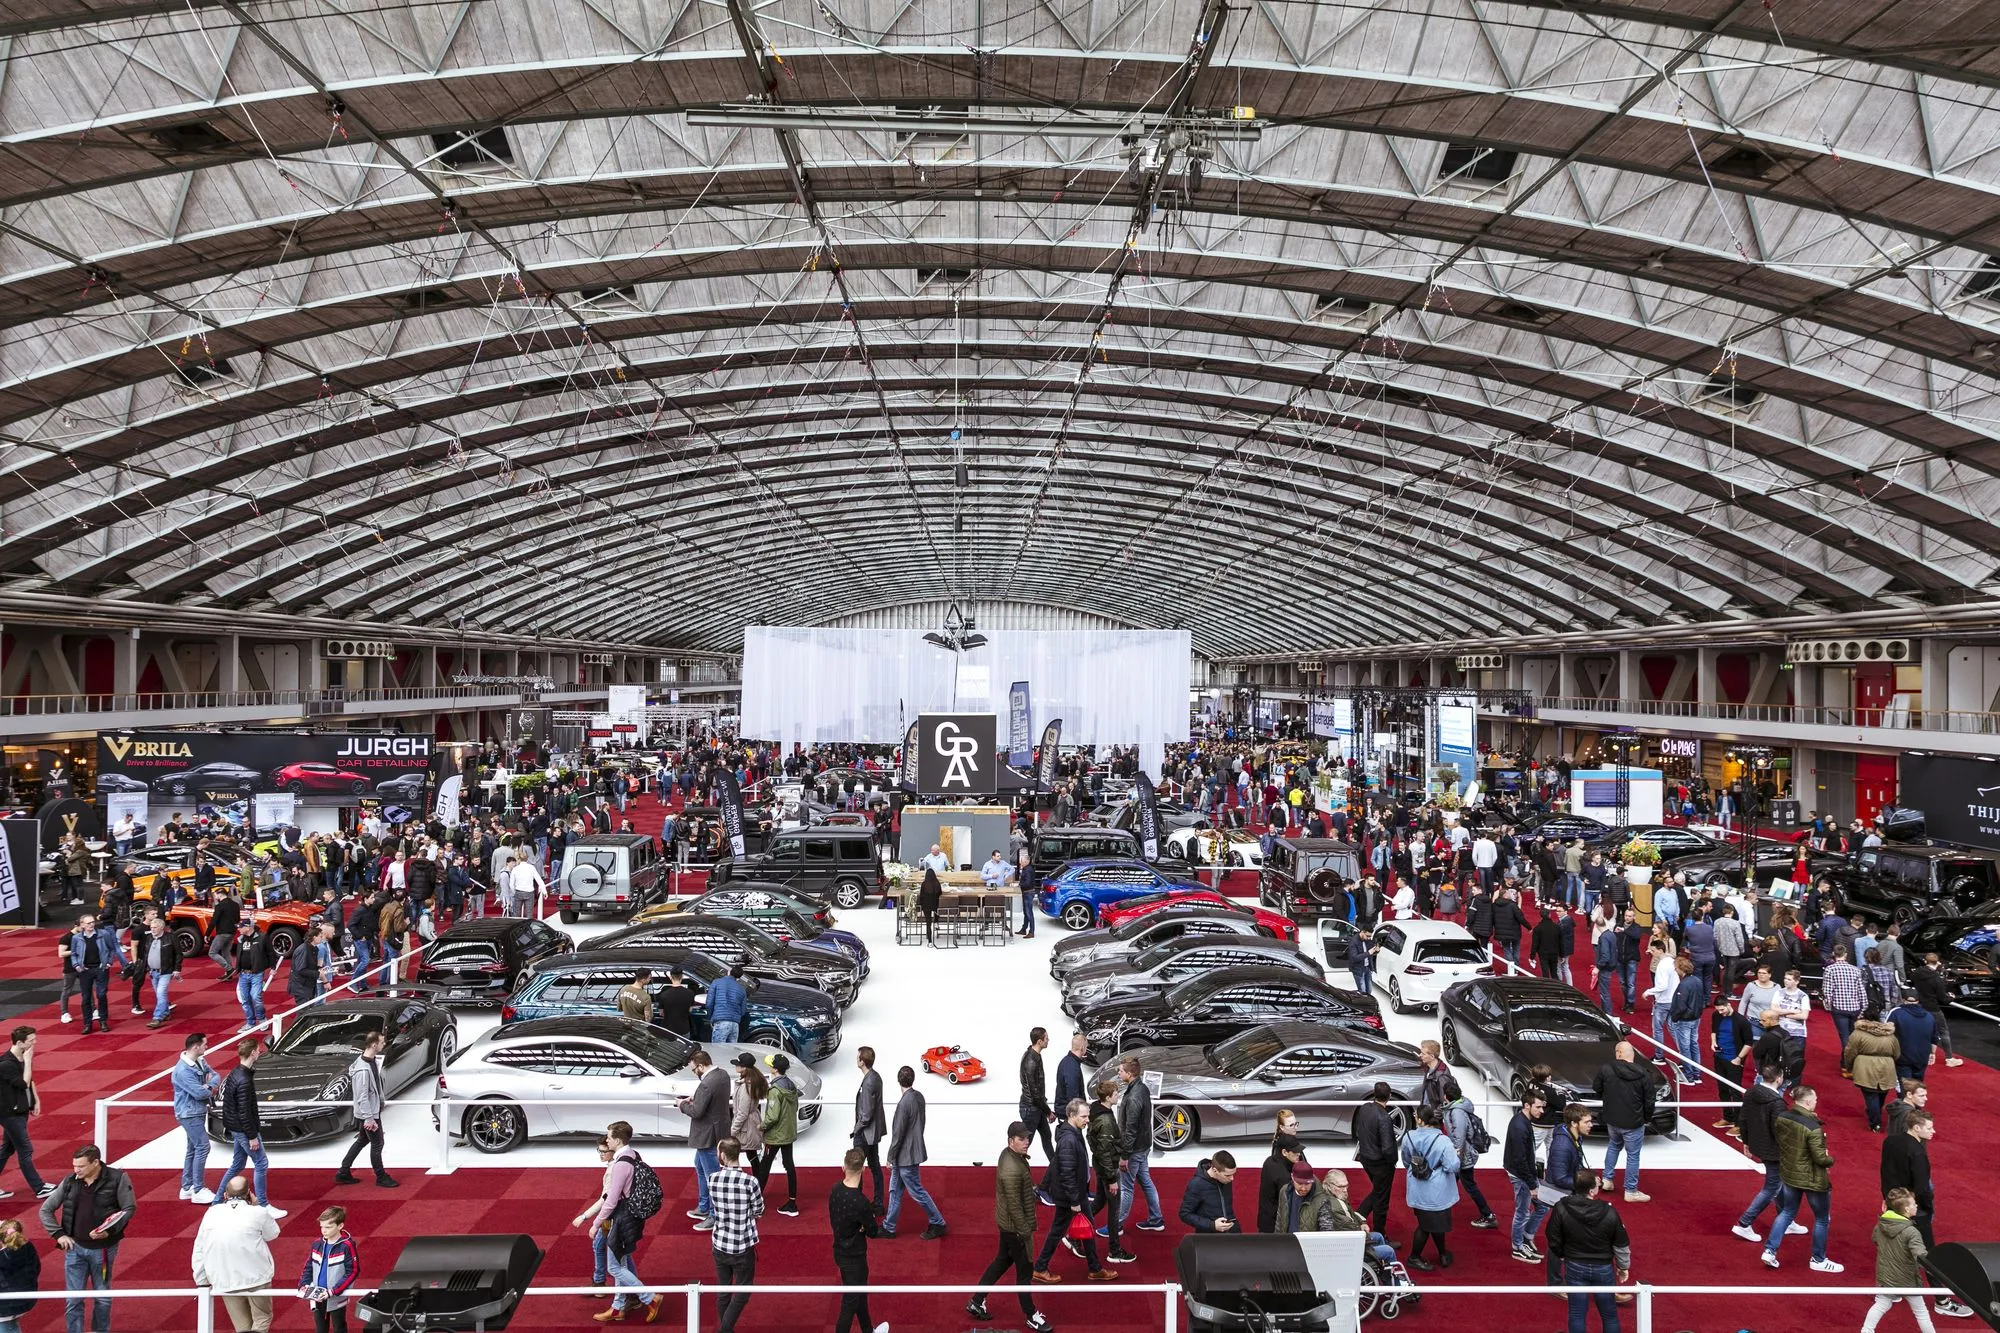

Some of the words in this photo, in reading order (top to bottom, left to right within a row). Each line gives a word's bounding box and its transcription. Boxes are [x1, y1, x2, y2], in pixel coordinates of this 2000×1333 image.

[133, 742, 194, 757] BRILA
[337, 738, 428, 756] JURGH
[126, 759, 145, 767] Drive
[337, 759, 362, 767] CAR
[366, 759, 428, 767] DETAILING
